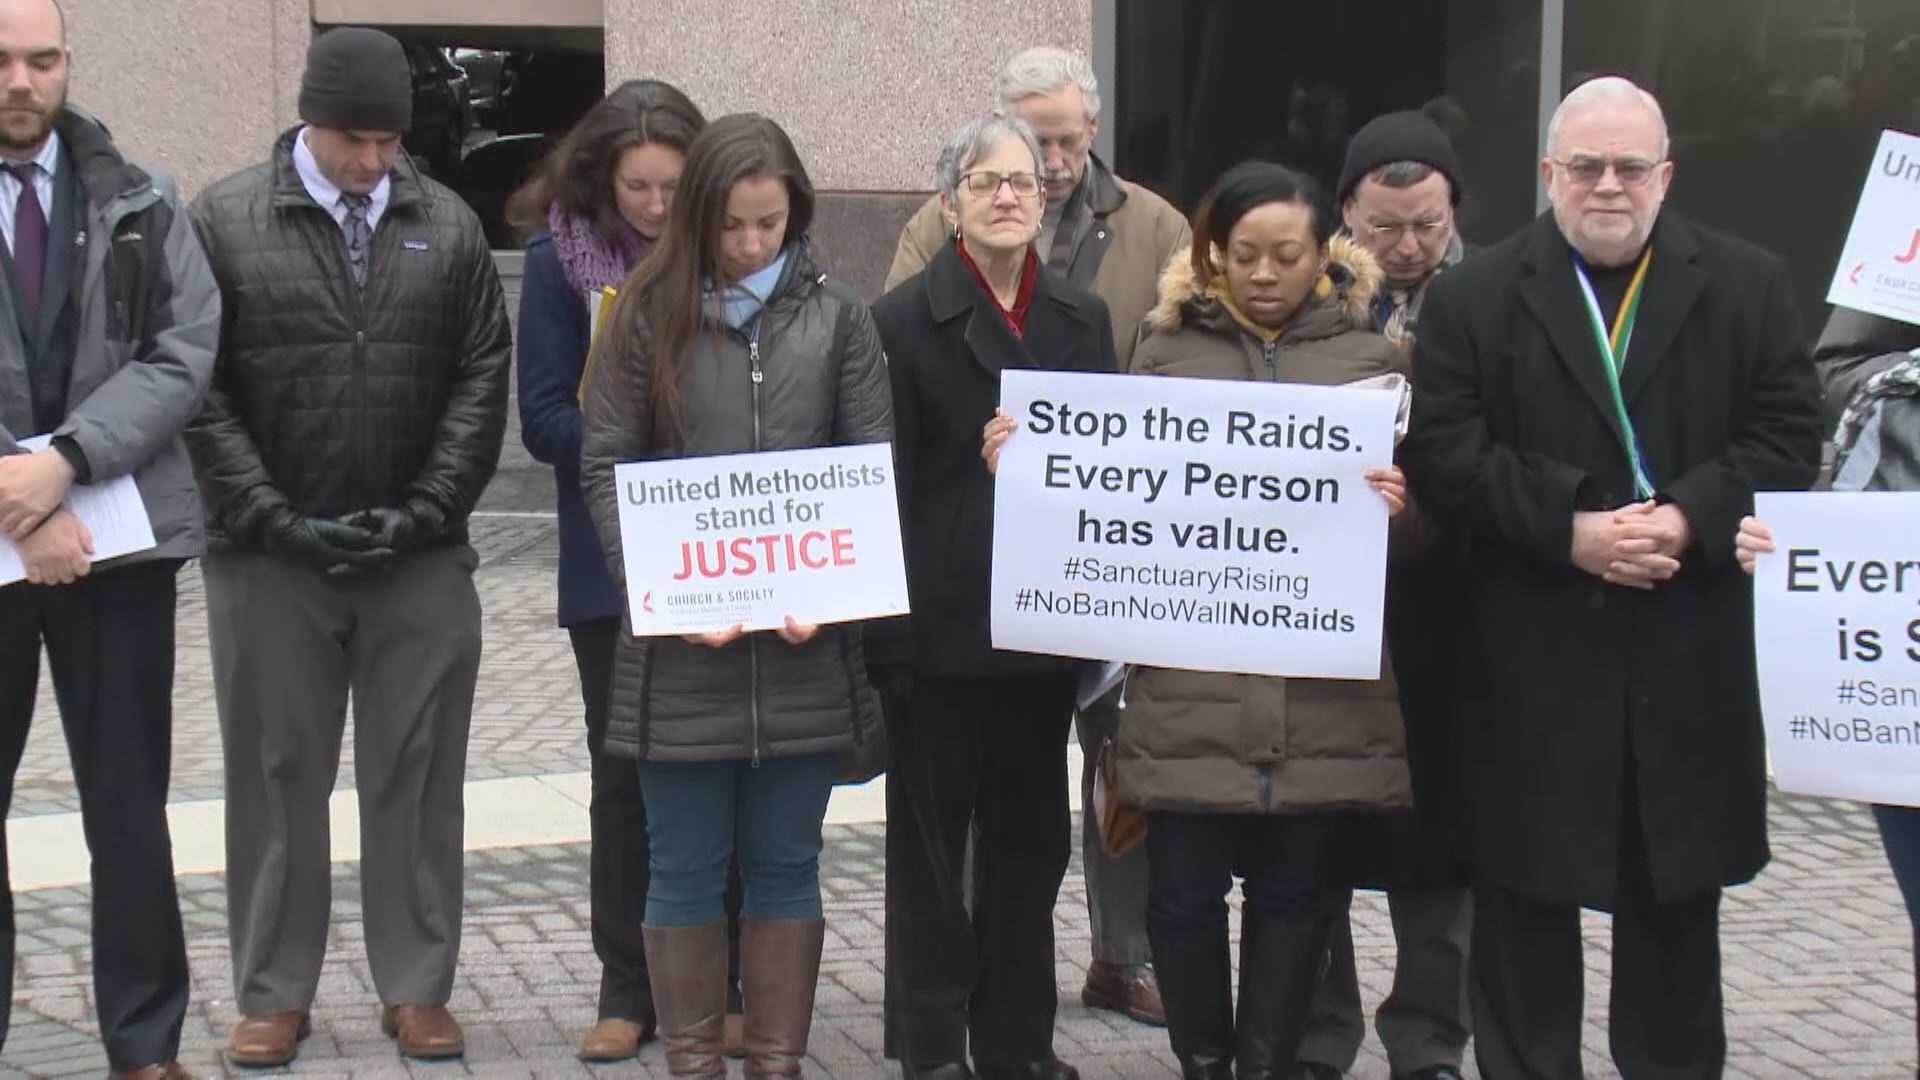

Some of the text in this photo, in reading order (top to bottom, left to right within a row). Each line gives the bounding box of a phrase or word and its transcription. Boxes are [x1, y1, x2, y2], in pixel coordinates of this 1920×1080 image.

[1028, 400, 1364, 453] Stop the Raids.
[627, 463, 886, 506] United Methodists
[1044, 454, 1340, 503] Every Person
[695, 498, 824, 531] stand for
[1077, 509, 1300, 554] has value.
[672, 528, 856, 580] JUSTICE
[667, 587, 774, 606] CHURCH & SOCIETY
[1064, 557, 1310, 600] #SanctuaryRising
[1787, 549, 1920, 606] Ever
[1015, 588, 1356, 633] #NoBanNoWallNoRaids
[1838, 618, 1883, 662] is
[1838, 680, 1918, 707] #San
[1790, 715, 1920, 745] #NoBan
